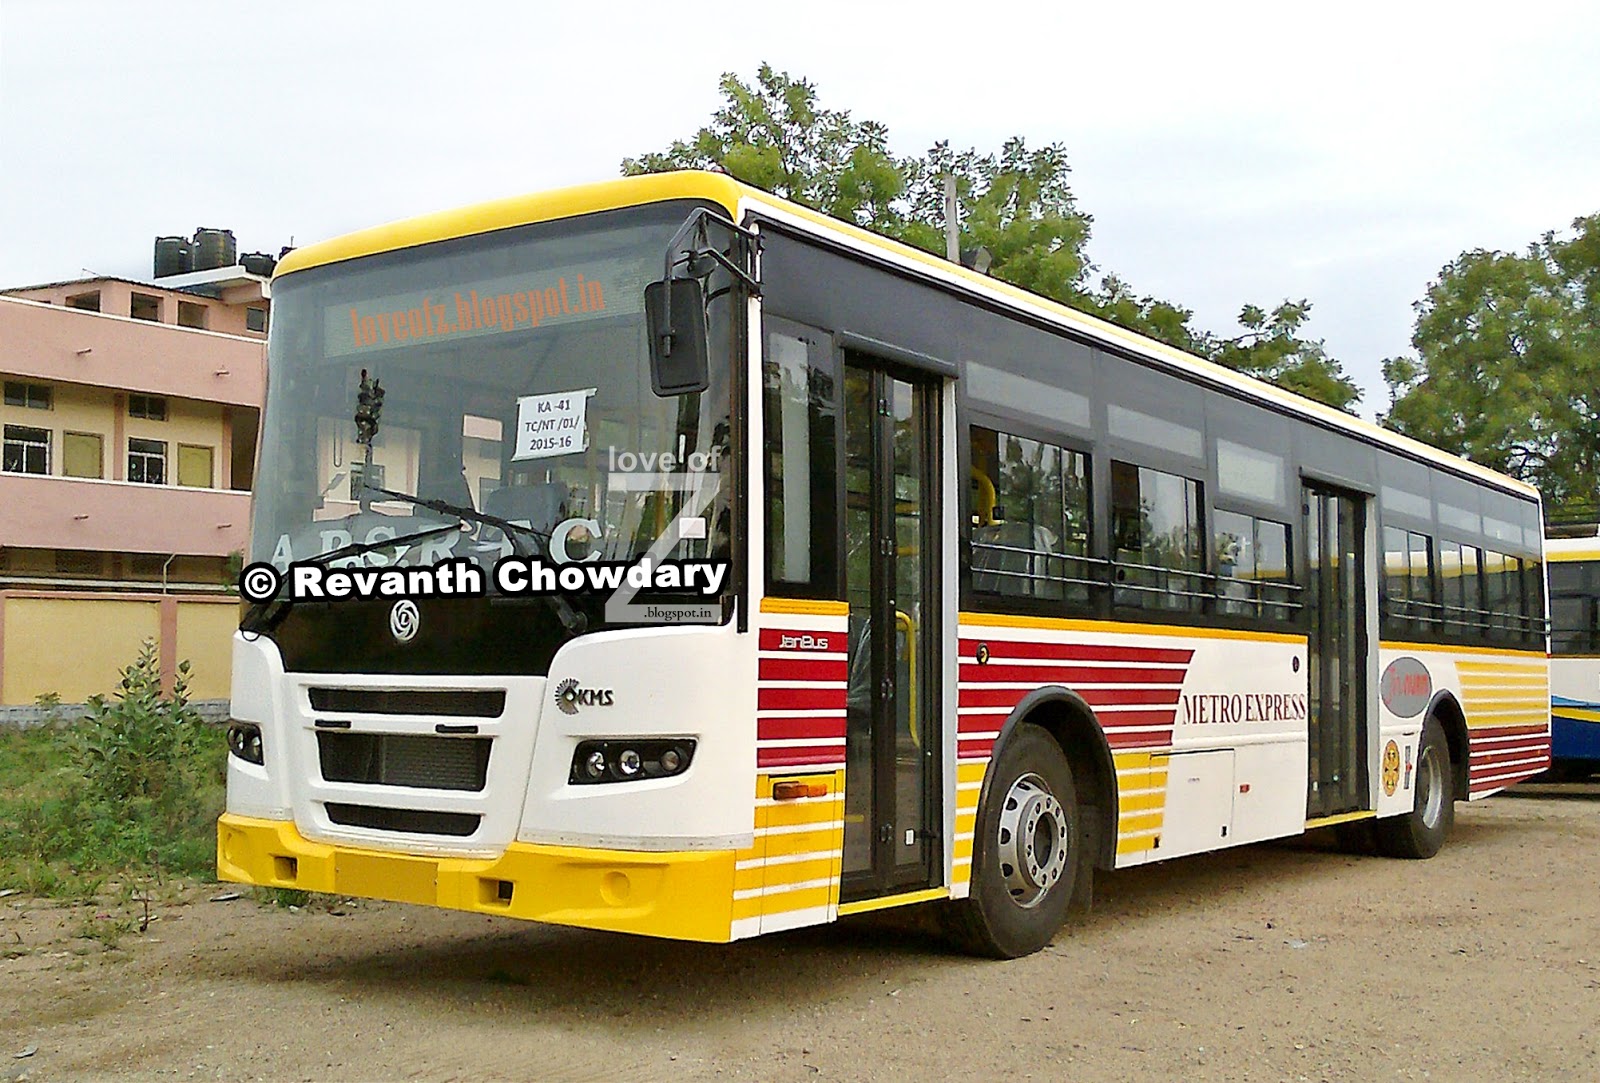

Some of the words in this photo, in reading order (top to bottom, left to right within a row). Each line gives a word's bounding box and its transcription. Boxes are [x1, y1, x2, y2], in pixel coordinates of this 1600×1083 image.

[537, 401, 552, 413] KA
[529, 435, 572, 450] 2015-16
[1182, 694, 1242, 725] METRO
[1245, 694, 1306, 721] EXPRESS
